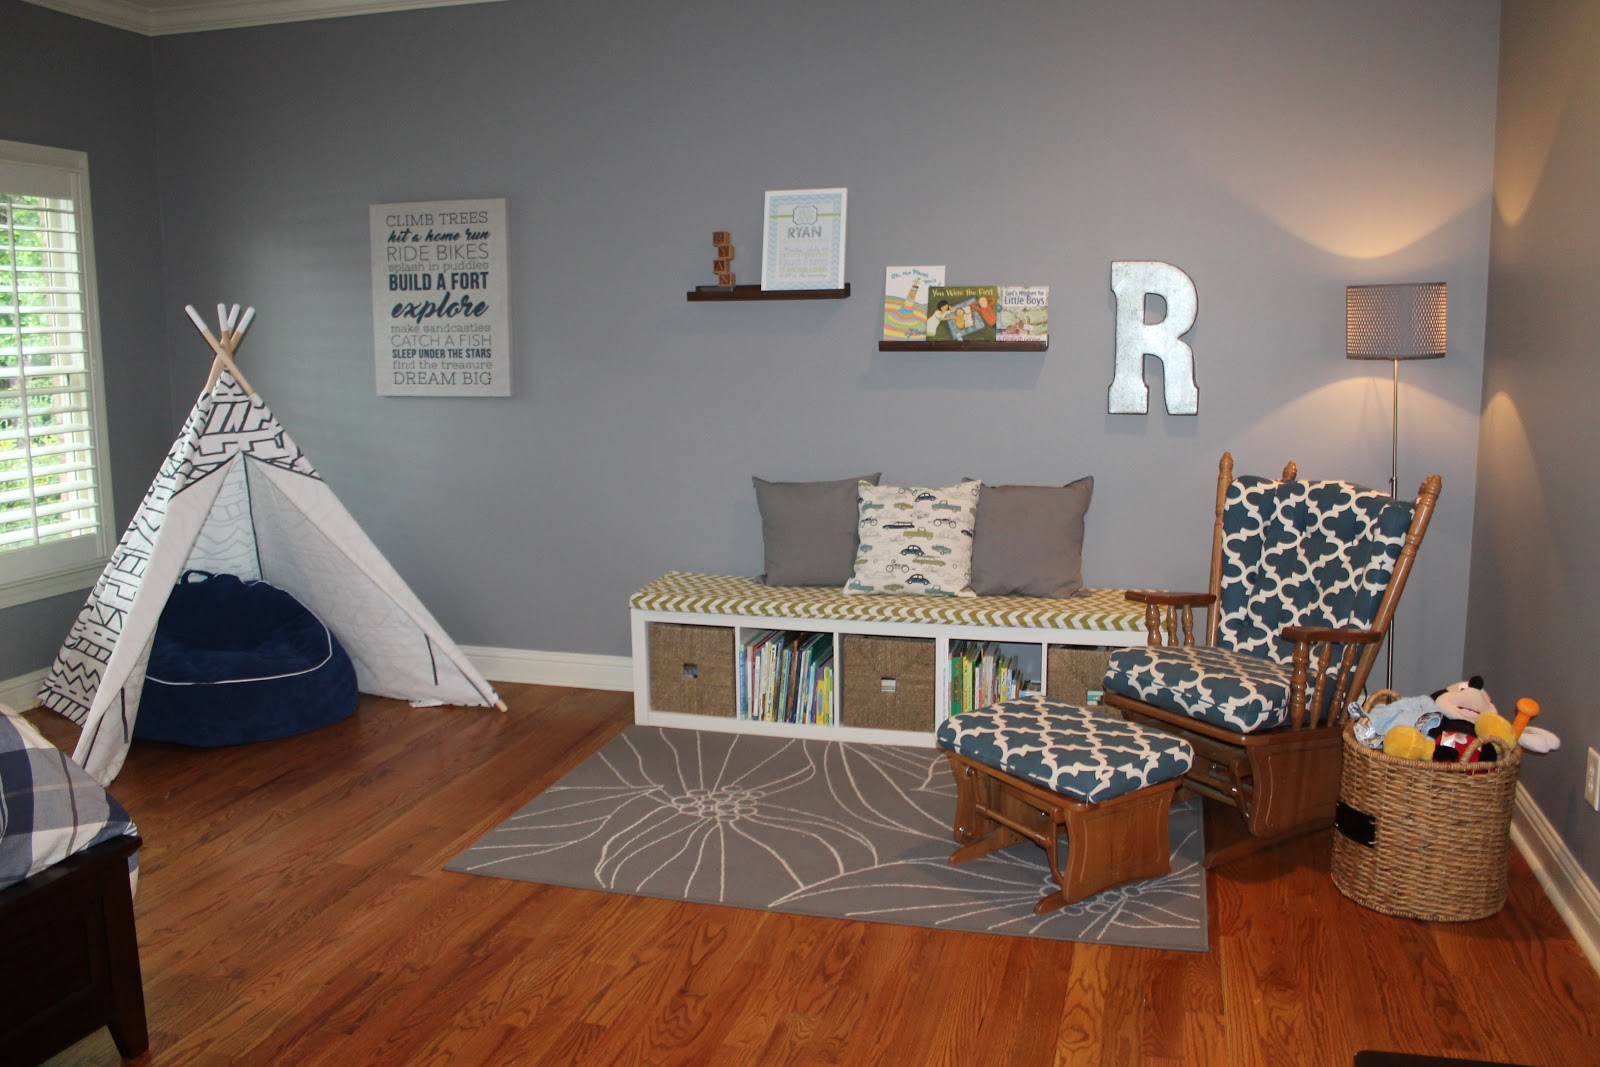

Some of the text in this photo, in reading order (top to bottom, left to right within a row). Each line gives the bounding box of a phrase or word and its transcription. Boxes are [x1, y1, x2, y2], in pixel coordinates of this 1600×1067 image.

[385, 211, 489, 227] CLIMB TREES
[387, 228, 491, 243] hit a home run
[787, 226, 822, 239] RYAN
[386, 242, 489, 261] RIDE BIKES
[388, 261, 489, 273] splash in puddles
[389, 271, 489, 291] BUILD A FORT
[931, 288, 994, 298] You Were the First
[1004, 294, 1045, 307] Little Boys
[390, 291, 490, 325] explore
[390, 323, 491, 334] make sandcastles
[390, 334, 492, 347] CATCH A FISH
[1108, 261, 1199, 416] R
[392, 348, 492, 359] SLEEP UNDER THE STARS
[392, 360, 493, 370] find the treasure
[393, 371, 493, 385] DREAM BIG
